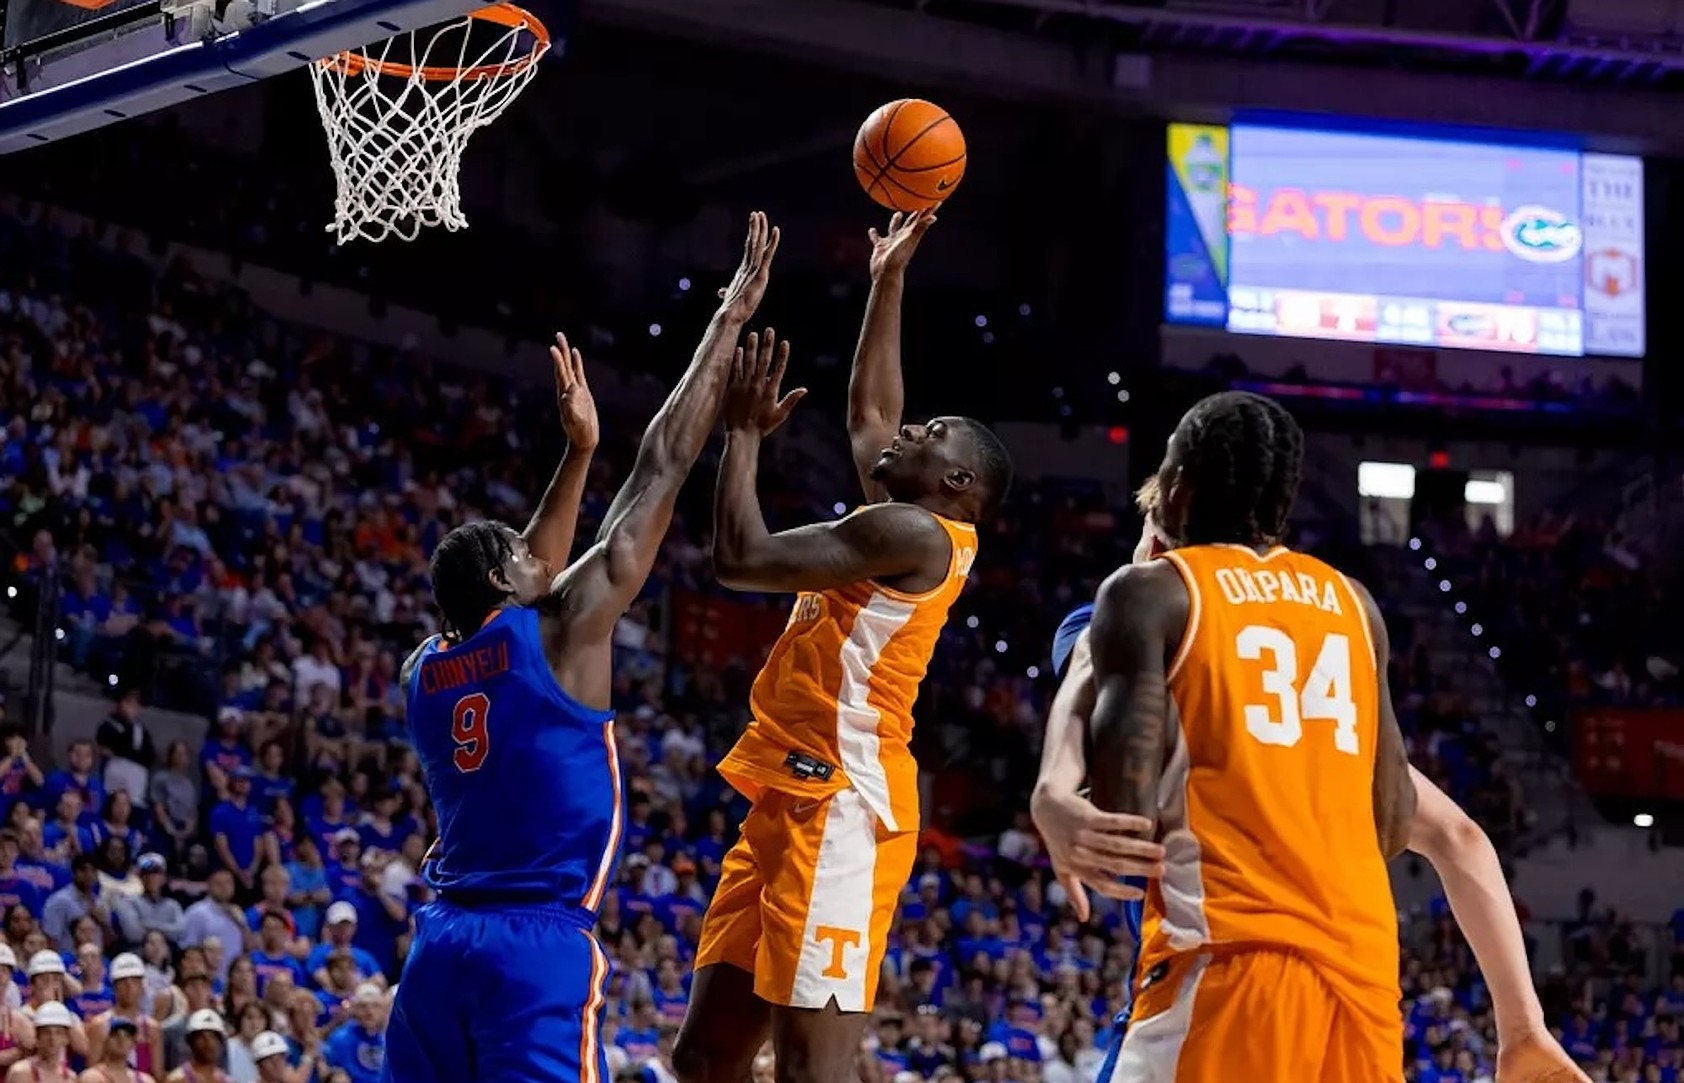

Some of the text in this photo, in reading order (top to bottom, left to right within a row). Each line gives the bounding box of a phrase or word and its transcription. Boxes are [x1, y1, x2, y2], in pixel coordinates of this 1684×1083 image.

[1215, 567, 1342, 615] OKPARA
[1236, 625, 1359, 755] 34
[452, 692, 491, 773] 9
[815, 926, 861, 980] T
